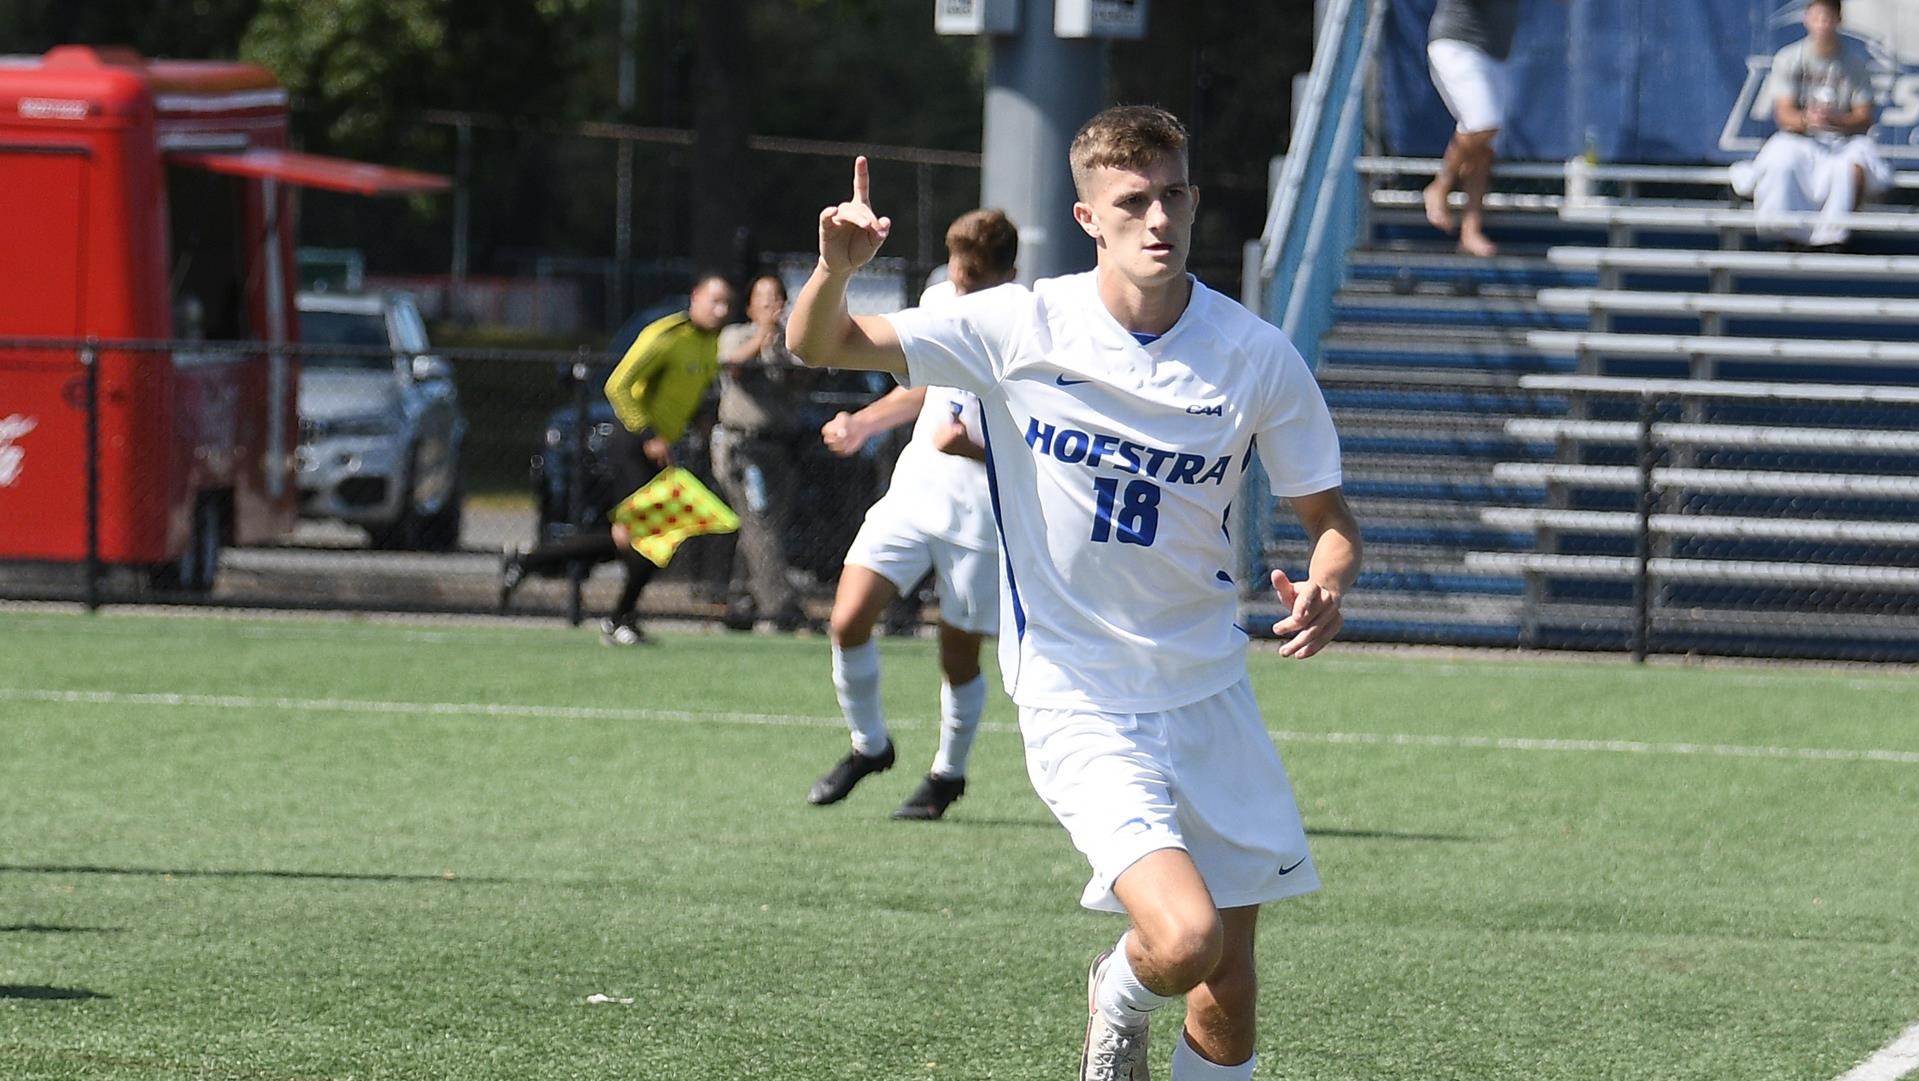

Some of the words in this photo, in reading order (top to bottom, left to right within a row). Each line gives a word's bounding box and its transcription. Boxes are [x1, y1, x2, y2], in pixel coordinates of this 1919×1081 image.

[1185, 404, 1222, 417] CAA
[1025, 416, 1232, 485] HOFSTRA
[1091, 477, 1160, 547] 18
